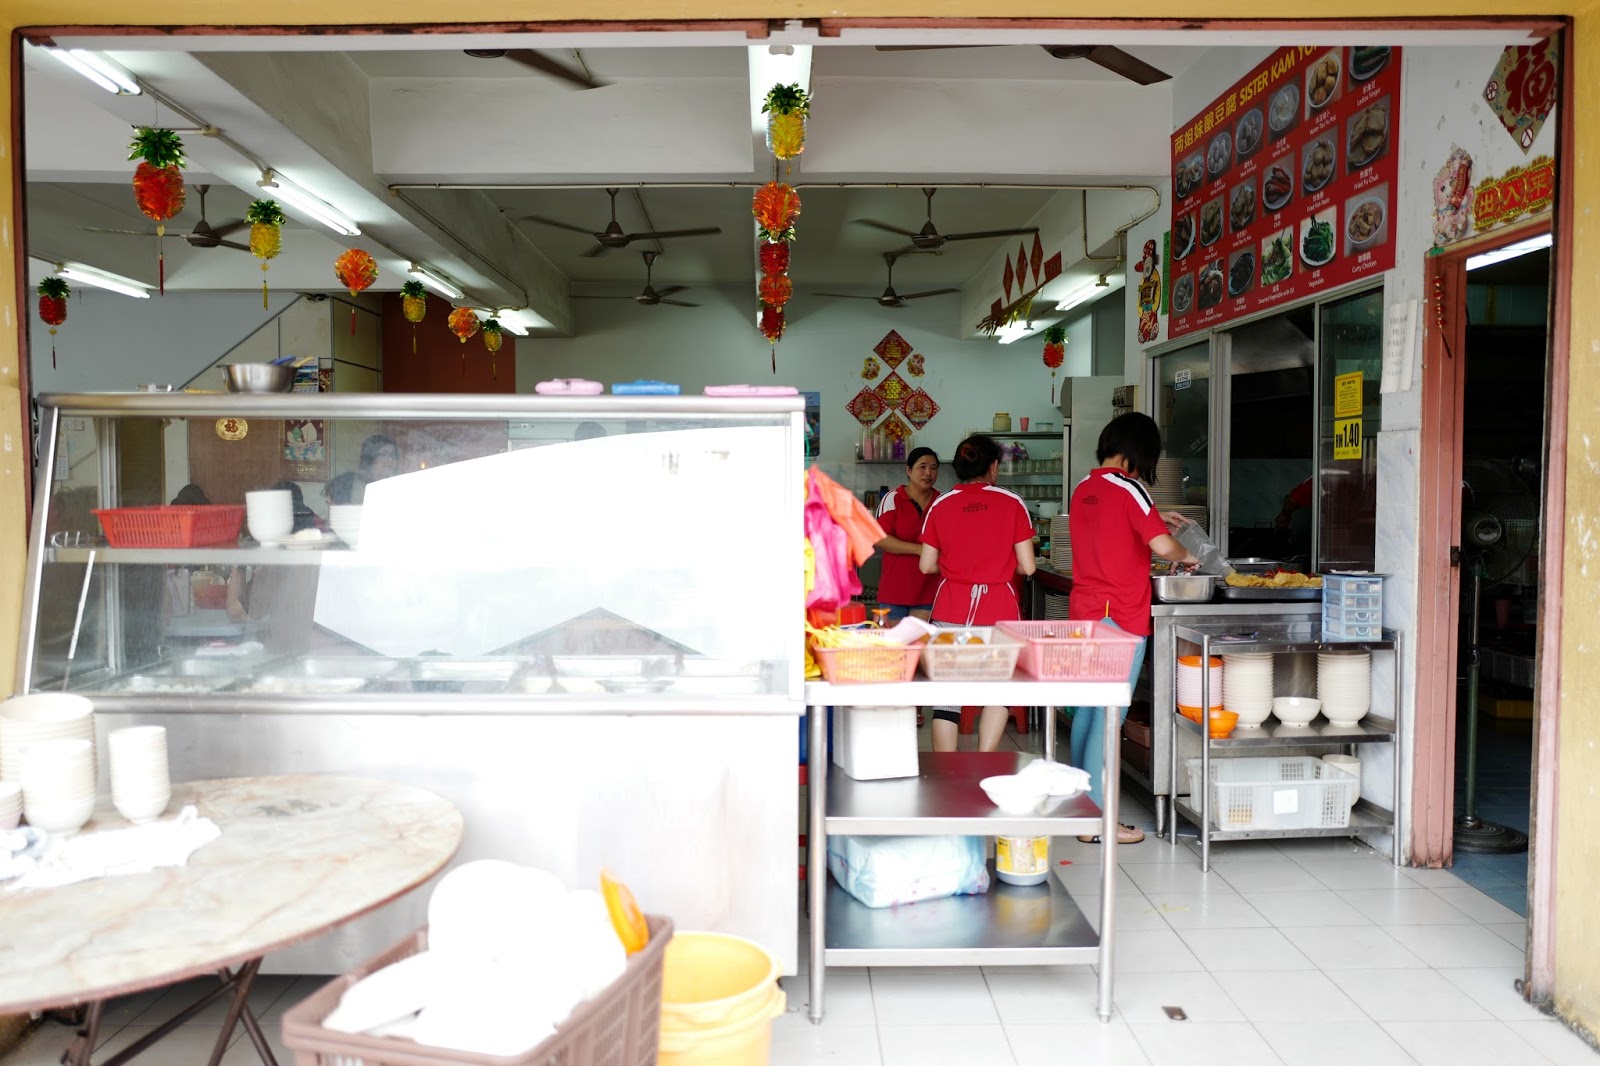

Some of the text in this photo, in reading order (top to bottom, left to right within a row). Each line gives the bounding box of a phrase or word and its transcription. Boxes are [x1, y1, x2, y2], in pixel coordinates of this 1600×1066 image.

[1240, 70, 1269, 106] SISTER
[1271, 49, 1296, 83] KAM
[1356, 86, 1381, 107] Ladies Finger
[1353, 181, 1363, 191] Fried
[1352, 259, 1377, 274] Curry Chicken
[1308, 277, 1324, 288] Vegetable
[1336, 423, 1359, 448] RM 1.40
